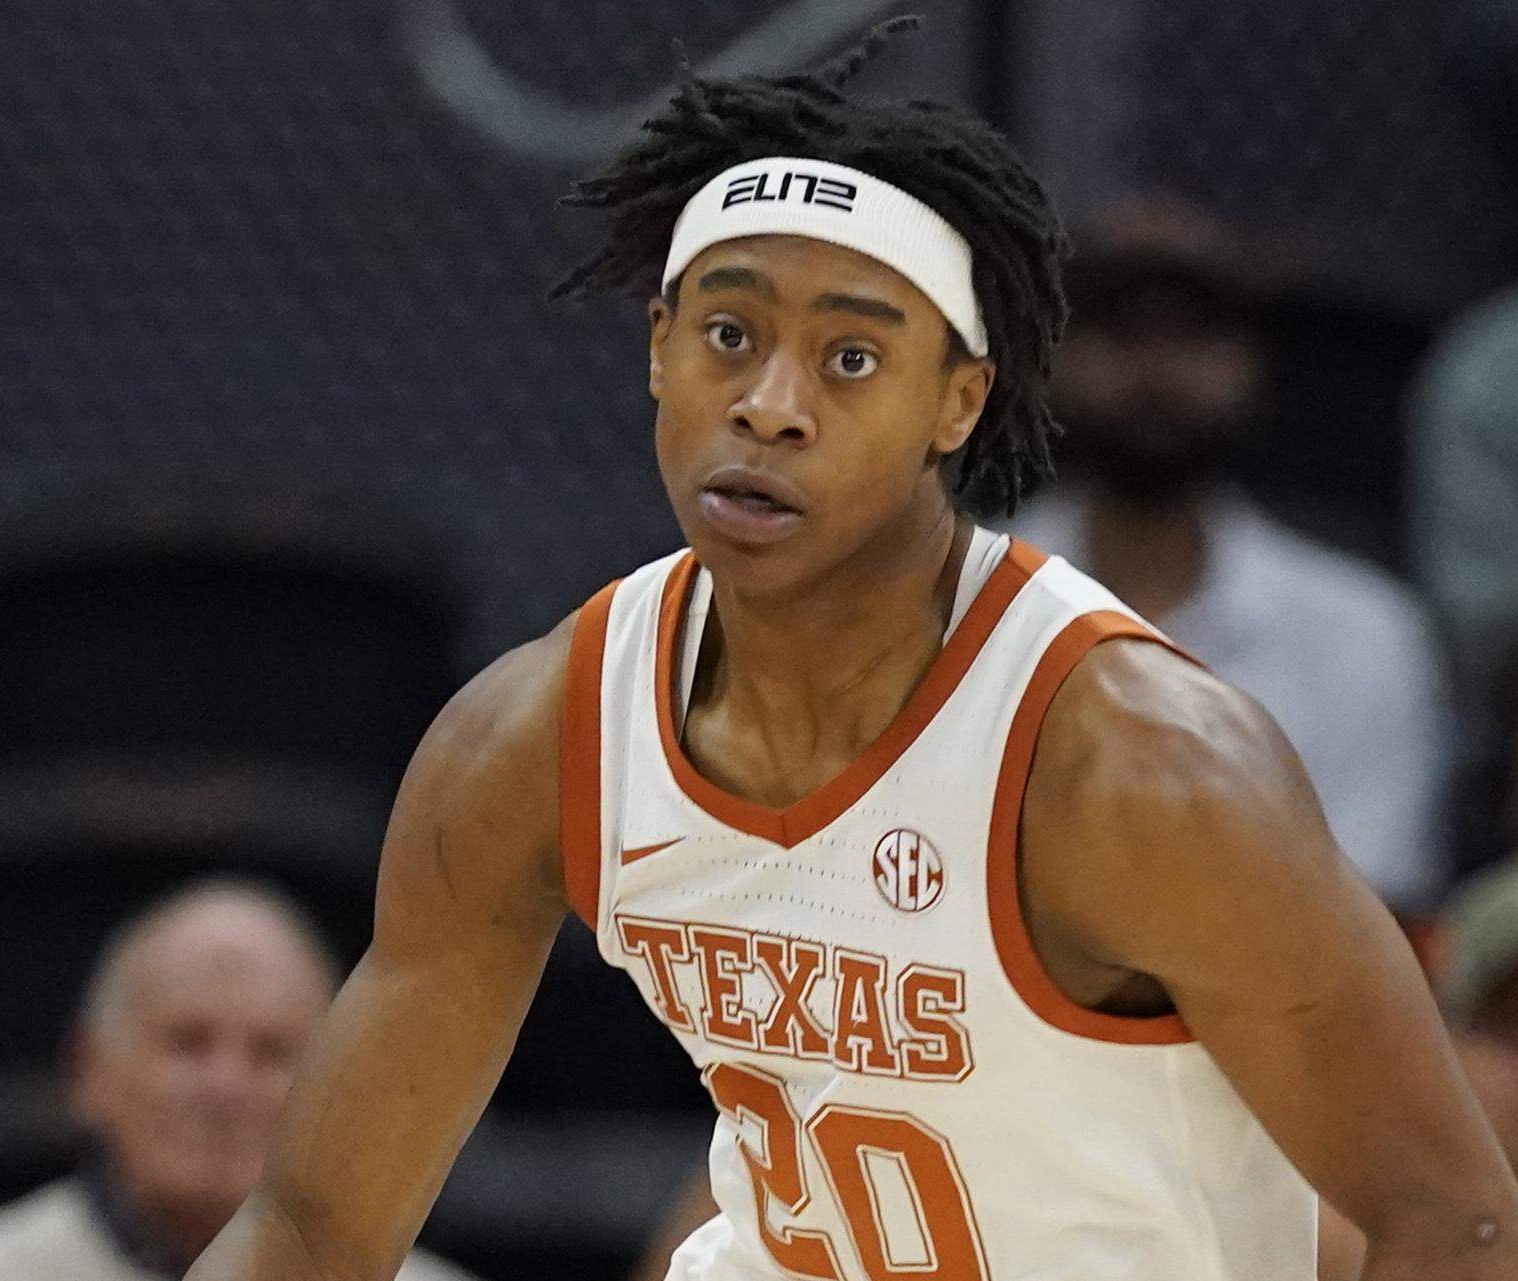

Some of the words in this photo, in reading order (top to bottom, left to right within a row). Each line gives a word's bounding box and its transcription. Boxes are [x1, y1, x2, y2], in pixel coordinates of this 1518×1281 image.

[721, 172, 857, 212] ELITE
[873, 829, 944, 911] SEC
[613, 913, 975, 1084] TEXAS
